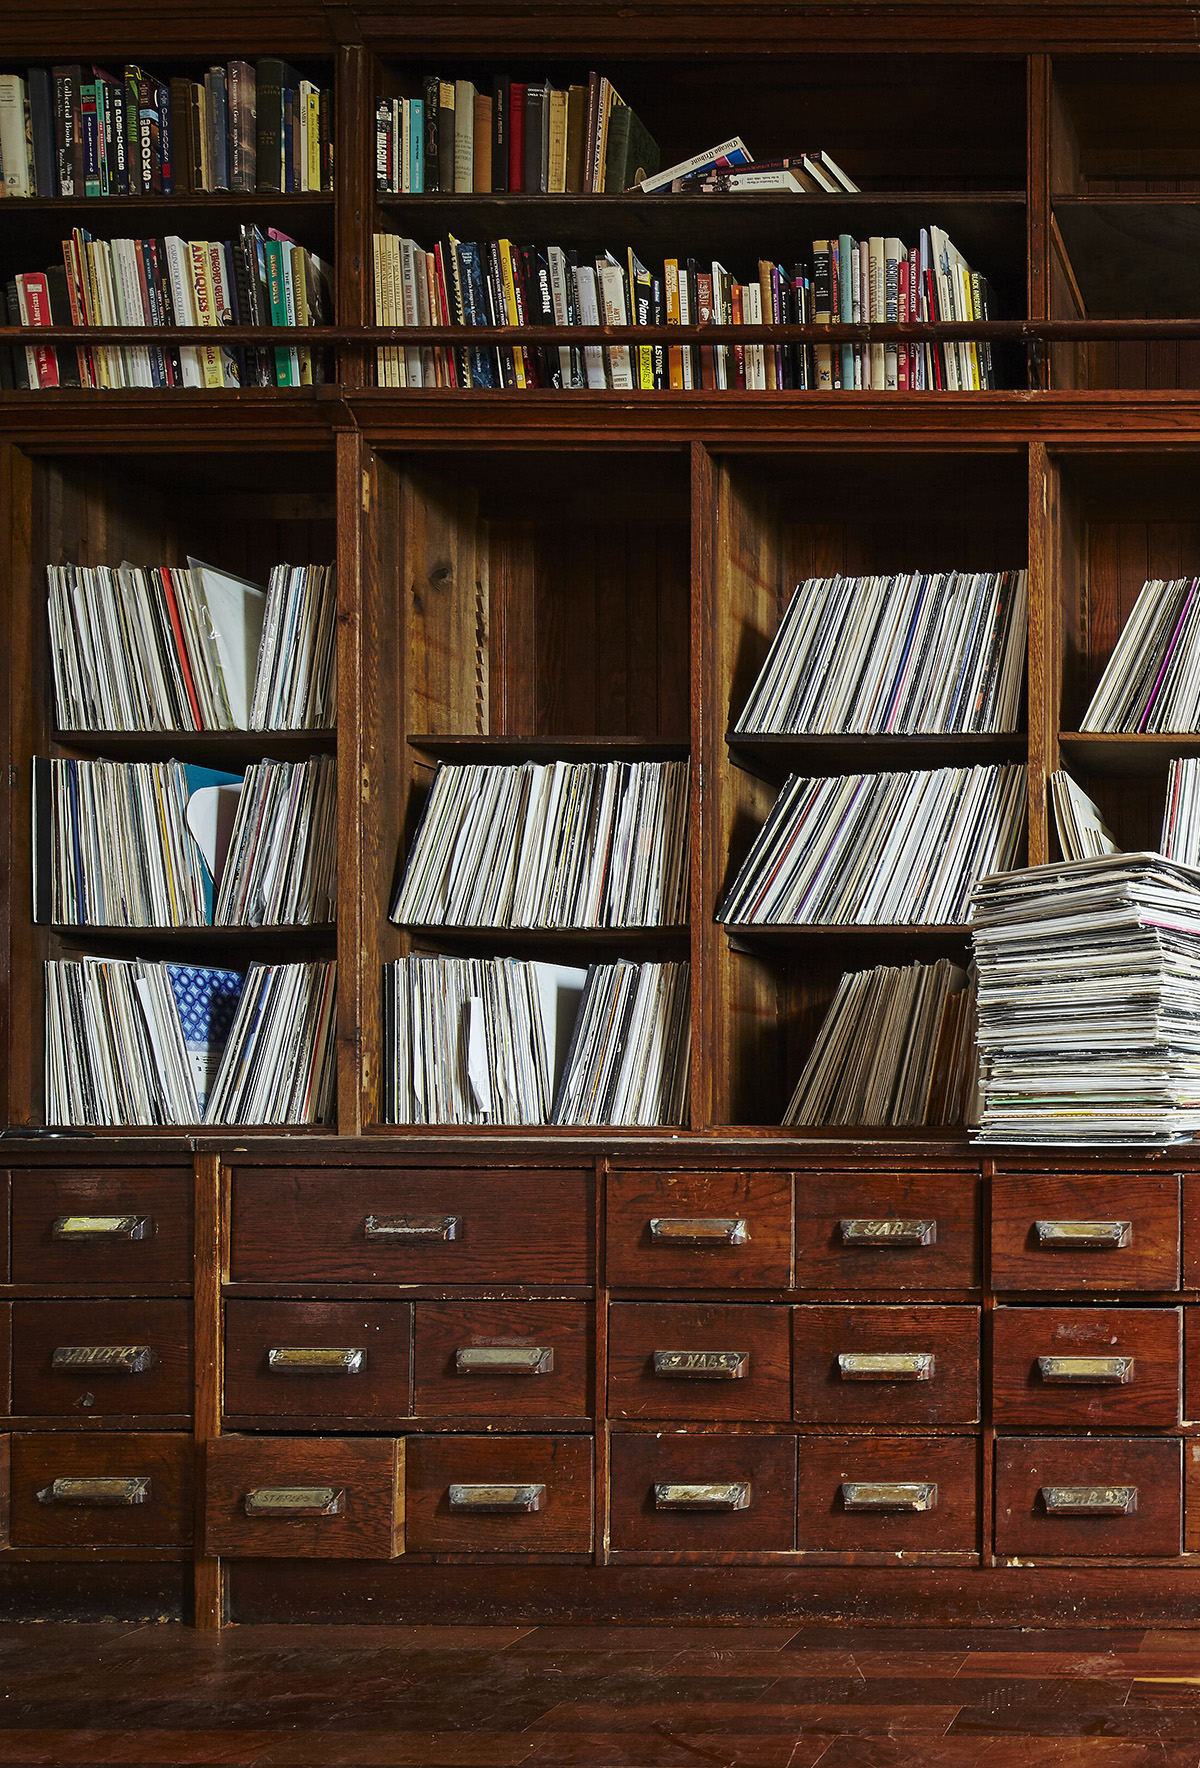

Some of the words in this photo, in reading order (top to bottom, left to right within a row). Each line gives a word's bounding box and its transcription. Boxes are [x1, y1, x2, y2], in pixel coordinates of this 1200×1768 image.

[63, 78, 72, 118] Collected
[115, 109, 124, 171] POSTCARDS
[141, 126, 151, 181] BOOKS
[377, 132, 387, 171] MALCOLM
[714, 140, 737, 154] Chicago
[690, 152, 714, 165] Tribune
[192, 244, 209, 312] ANTIQUES
[210, 248, 222, 284] RECORD
[886, 259, 897, 301] DISCOVERING
[971, 273, 979, 289] BLACK
[31, 293, 41, 321] Americans
[214, 286, 226, 311] GUIDE
[639, 298, 650, 325] Piano
[973, 290, 982, 320] AMERICANA
[297, 311, 302, 321] OF
[642, 347, 650, 383] DUMMIES
